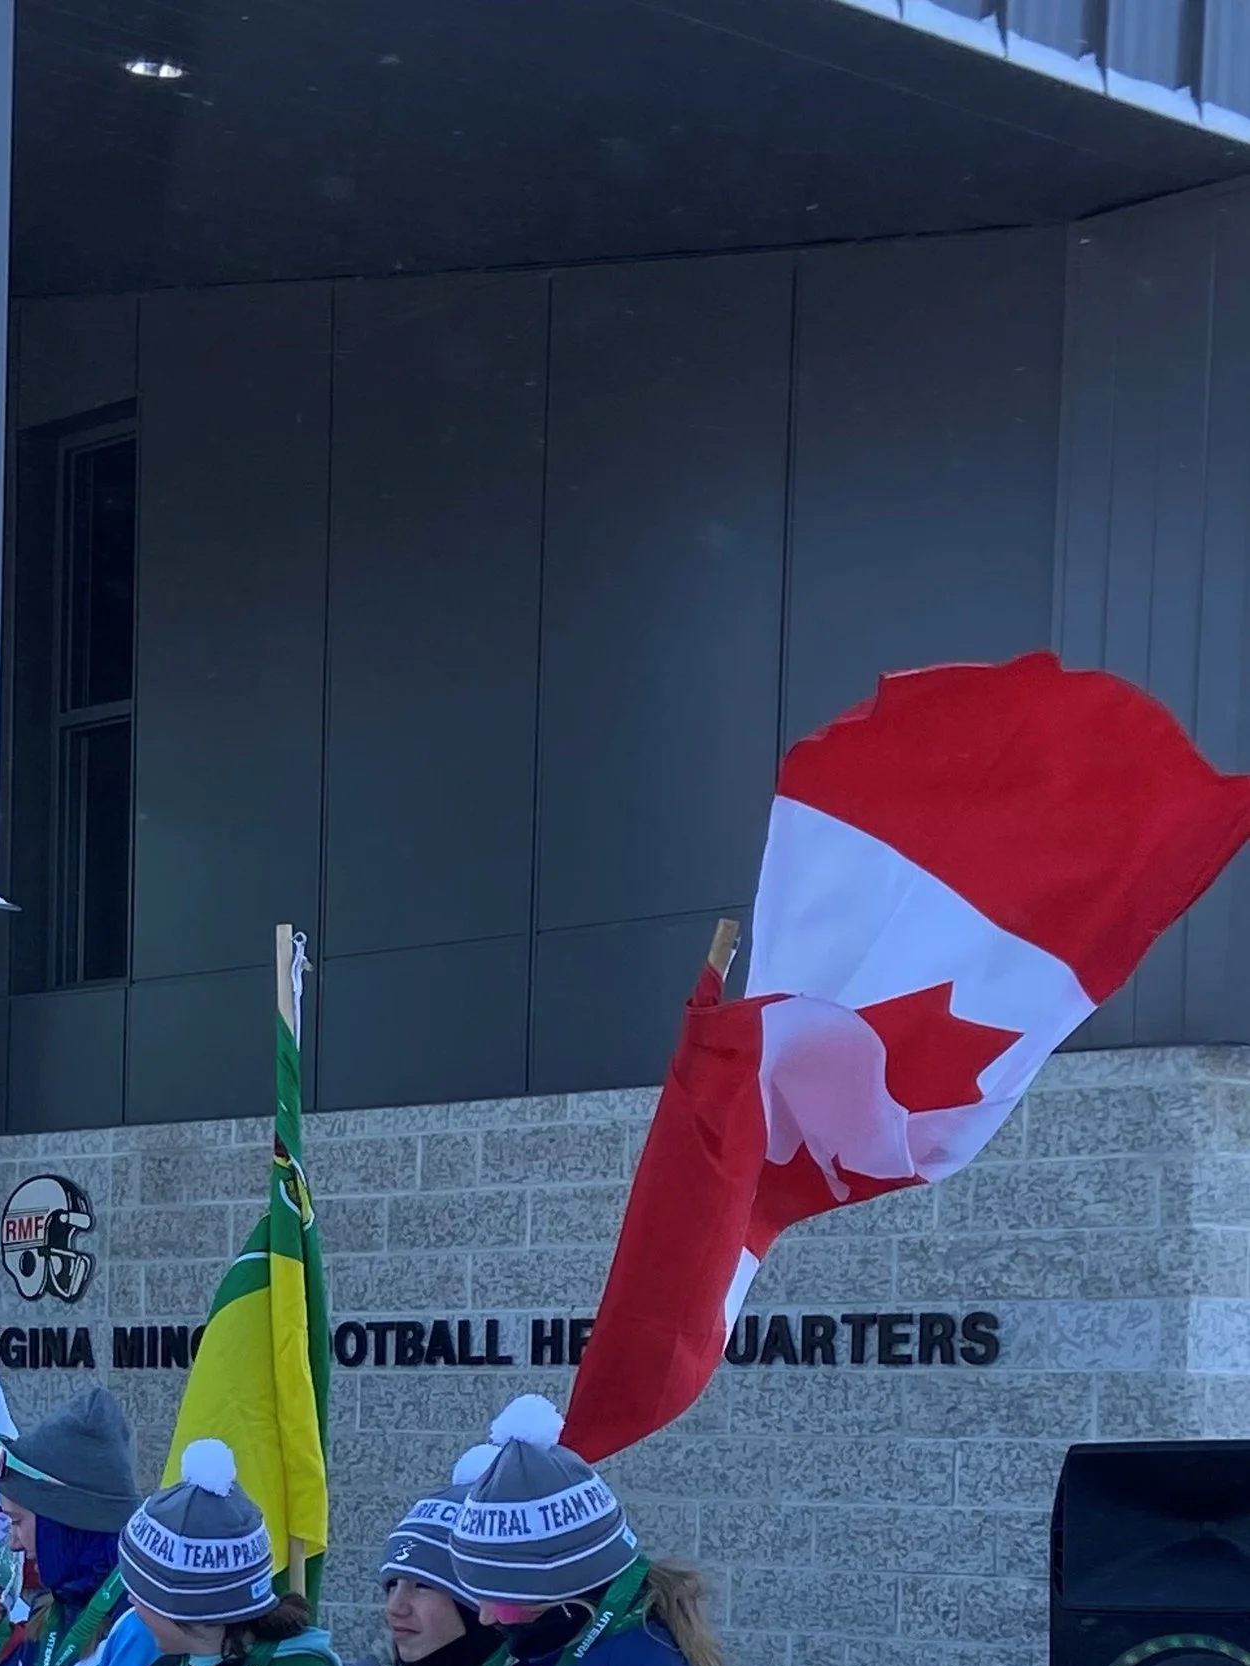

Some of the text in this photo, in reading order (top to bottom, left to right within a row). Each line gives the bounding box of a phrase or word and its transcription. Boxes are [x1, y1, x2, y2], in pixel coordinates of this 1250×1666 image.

[6, 1216, 44, 1241] RMF
[112, 1325, 207, 1369] MIN
[329, 1318, 512, 1367] OTBALL
[460, 1506, 532, 1537] CENTRAL
[538, 1494, 590, 1528] TEAM
[131, 1511, 175, 1563] CENTRAL
[183, 1543, 229, 1569] TEAM
[573, 1610, 614, 1658] VITERRA
